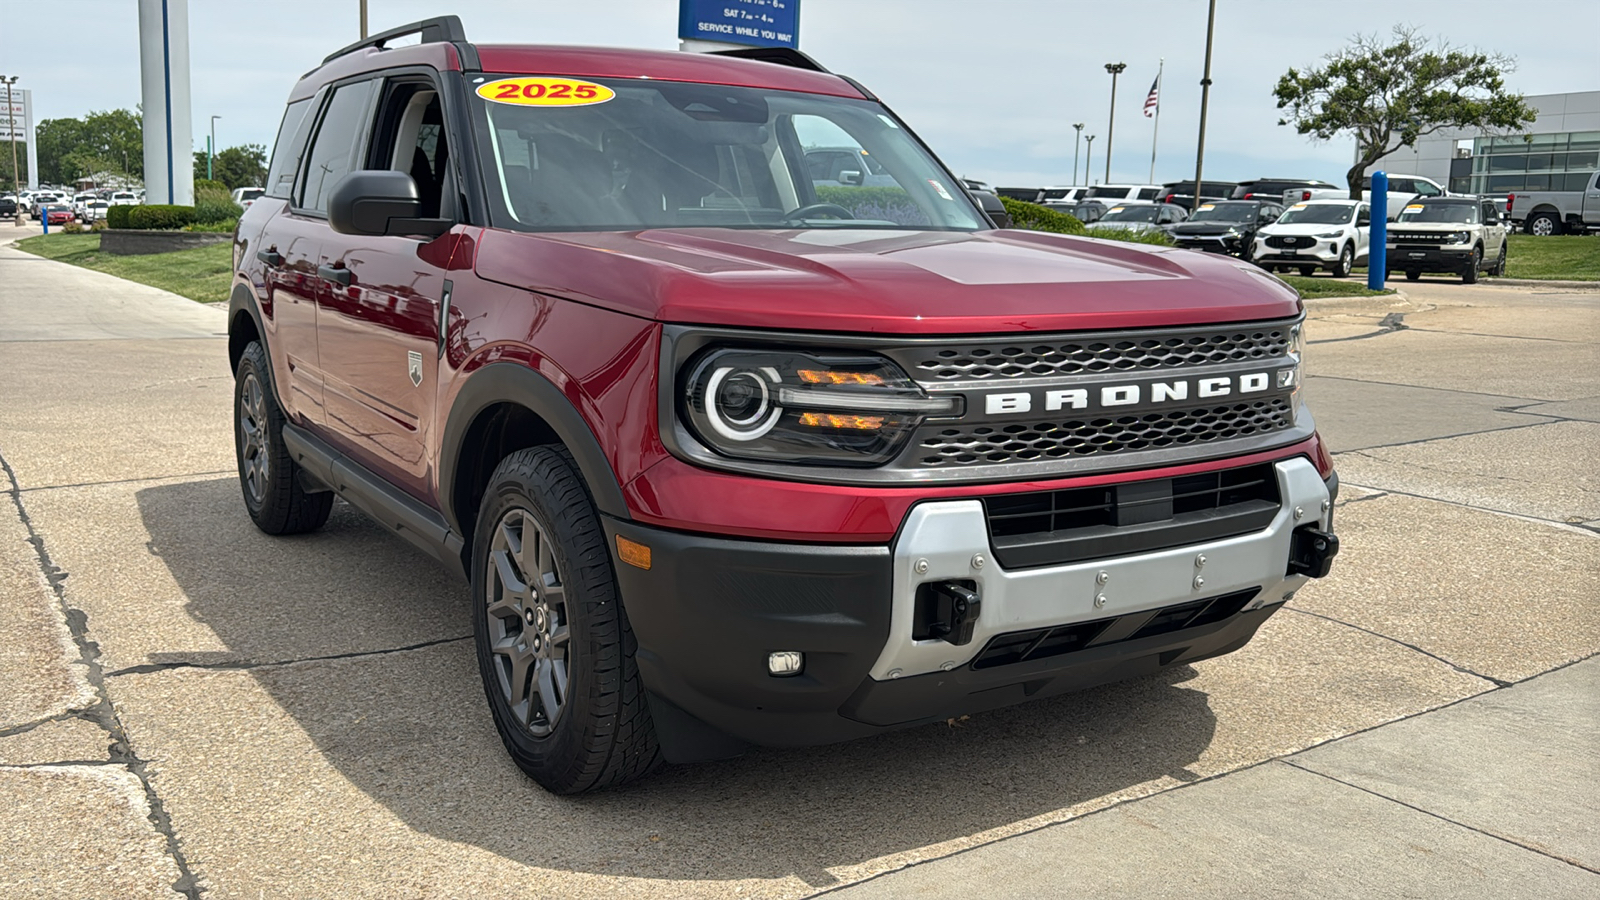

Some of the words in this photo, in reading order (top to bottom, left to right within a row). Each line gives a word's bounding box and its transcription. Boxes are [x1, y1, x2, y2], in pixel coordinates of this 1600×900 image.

[723, 8, 739, 18] SAT
[698, 22, 733, 34] SERVICE
[735, 26, 759, 37] WHILE
[761, 30, 775, 40] YOU
[777, 32, 792, 43] WAIT
[494, 83, 598, 99] 2025
[984, 372, 1270, 415] BRONCO
